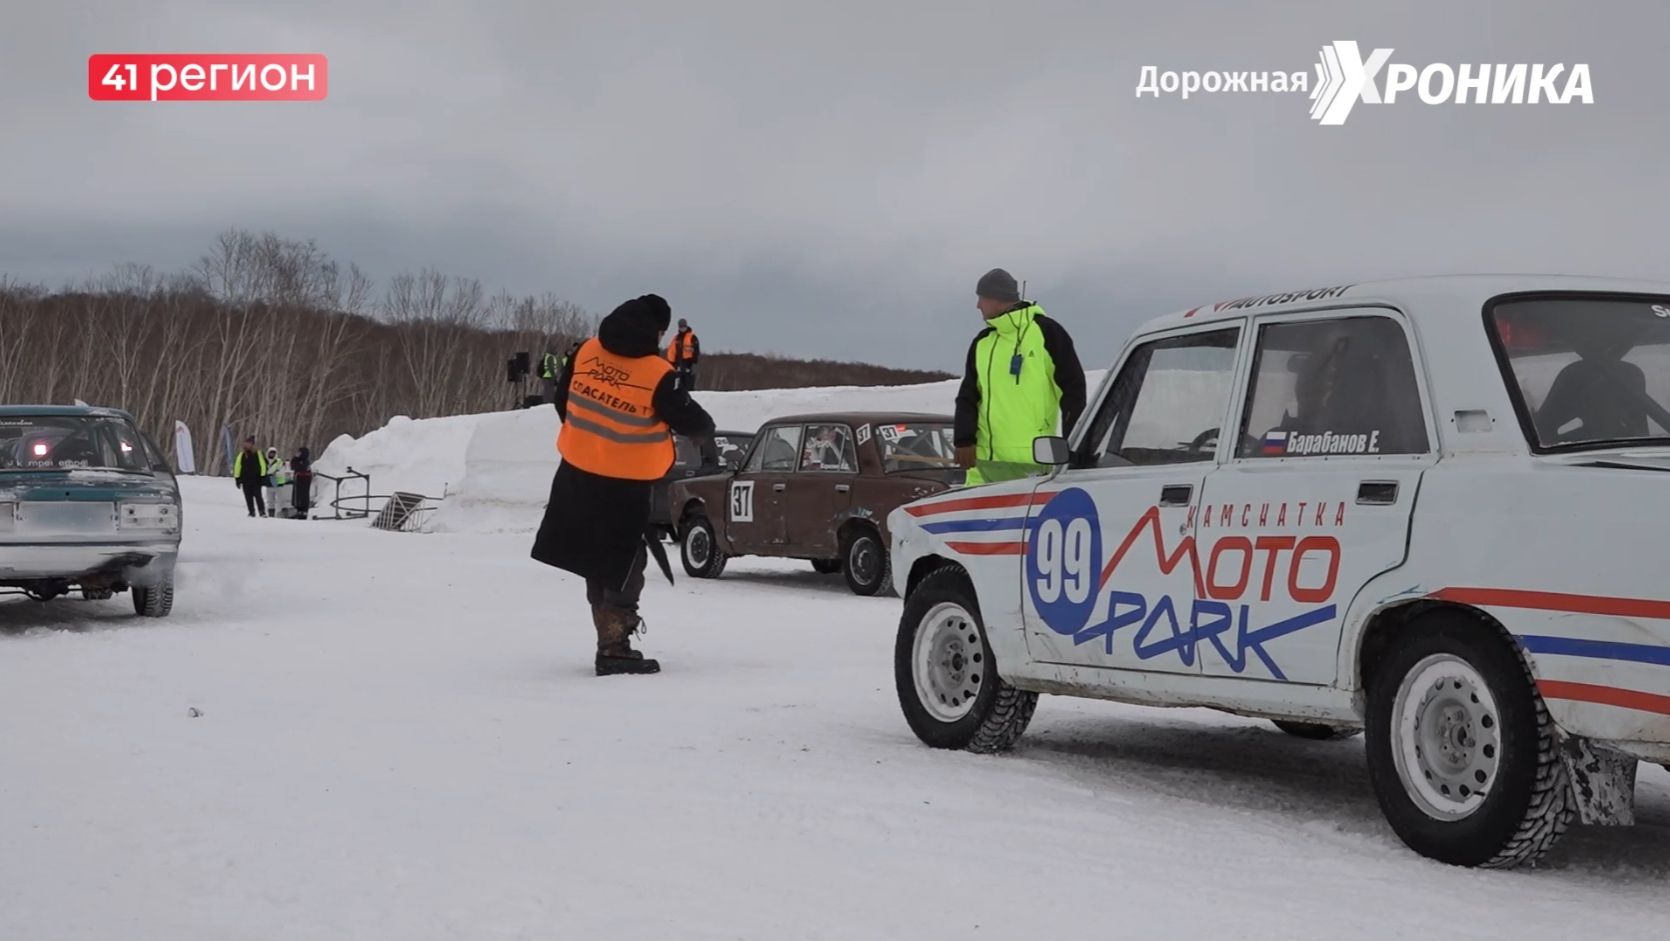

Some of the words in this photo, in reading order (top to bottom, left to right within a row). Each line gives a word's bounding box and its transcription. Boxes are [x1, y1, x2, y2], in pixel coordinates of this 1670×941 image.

[582, 356, 630, 382] MOTO
[573, 380, 637, 413] СПАСАТЕЛЬ
[857, 426, 869, 443] 37
[881, 426, 898, 440] 37
[1286, 431, 1367, 455] Барабанов
[733, 485, 751, 517] 37
[1187, 501, 1346, 529] KAMCHATKA
[1036, 517, 1093, 604] 99
[1099, 505, 1342, 604] MOTO
[1073, 589, 1337, 682] PARK
